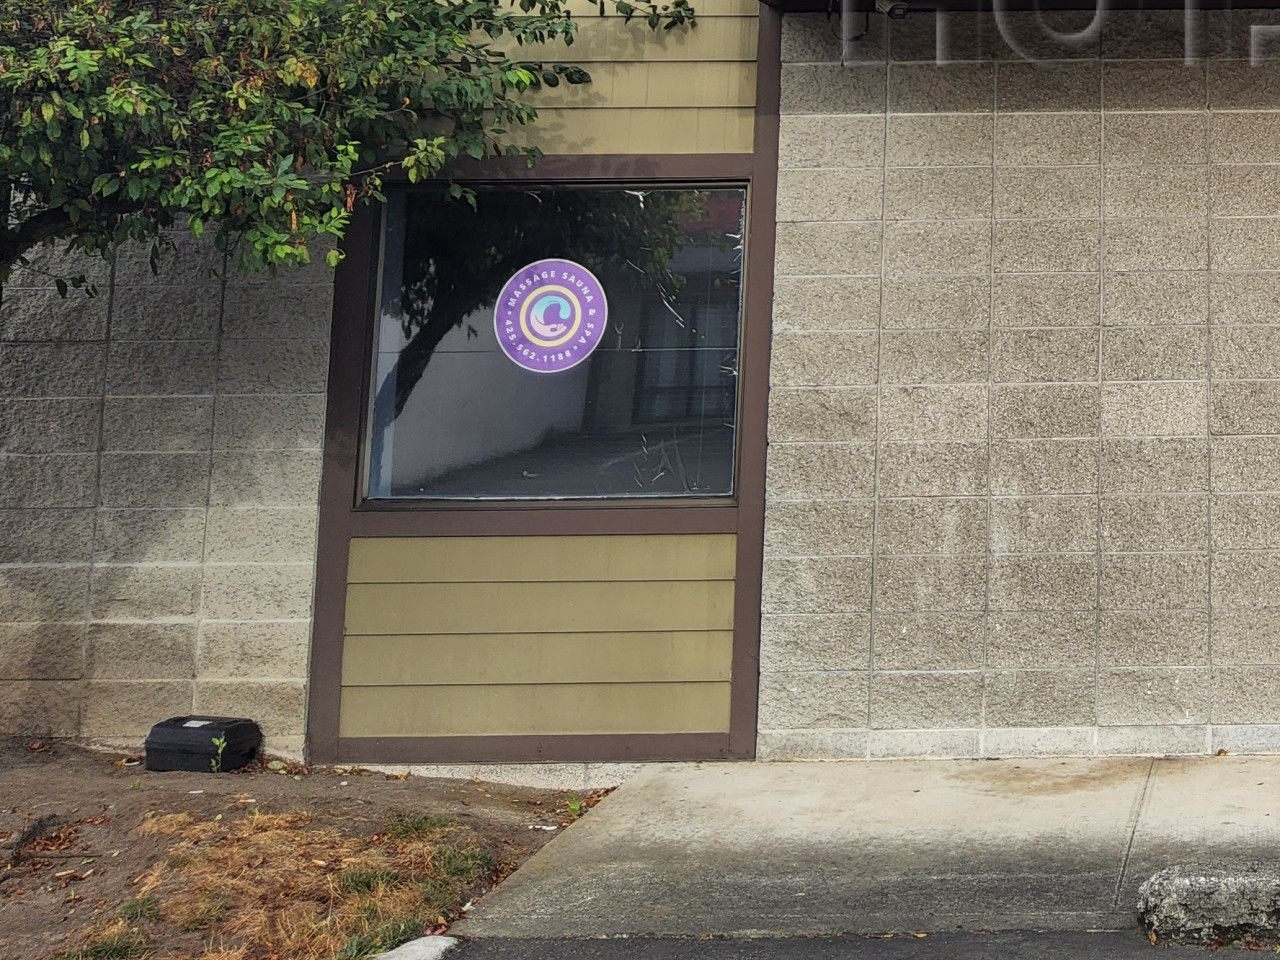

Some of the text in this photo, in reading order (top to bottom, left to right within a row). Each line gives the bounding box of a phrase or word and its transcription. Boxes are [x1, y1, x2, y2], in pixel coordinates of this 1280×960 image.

[508, 270, 557, 307] MASSAGE
[562, 272, 594, 302] SAUNA
[578, 323, 594, 344] SPA
